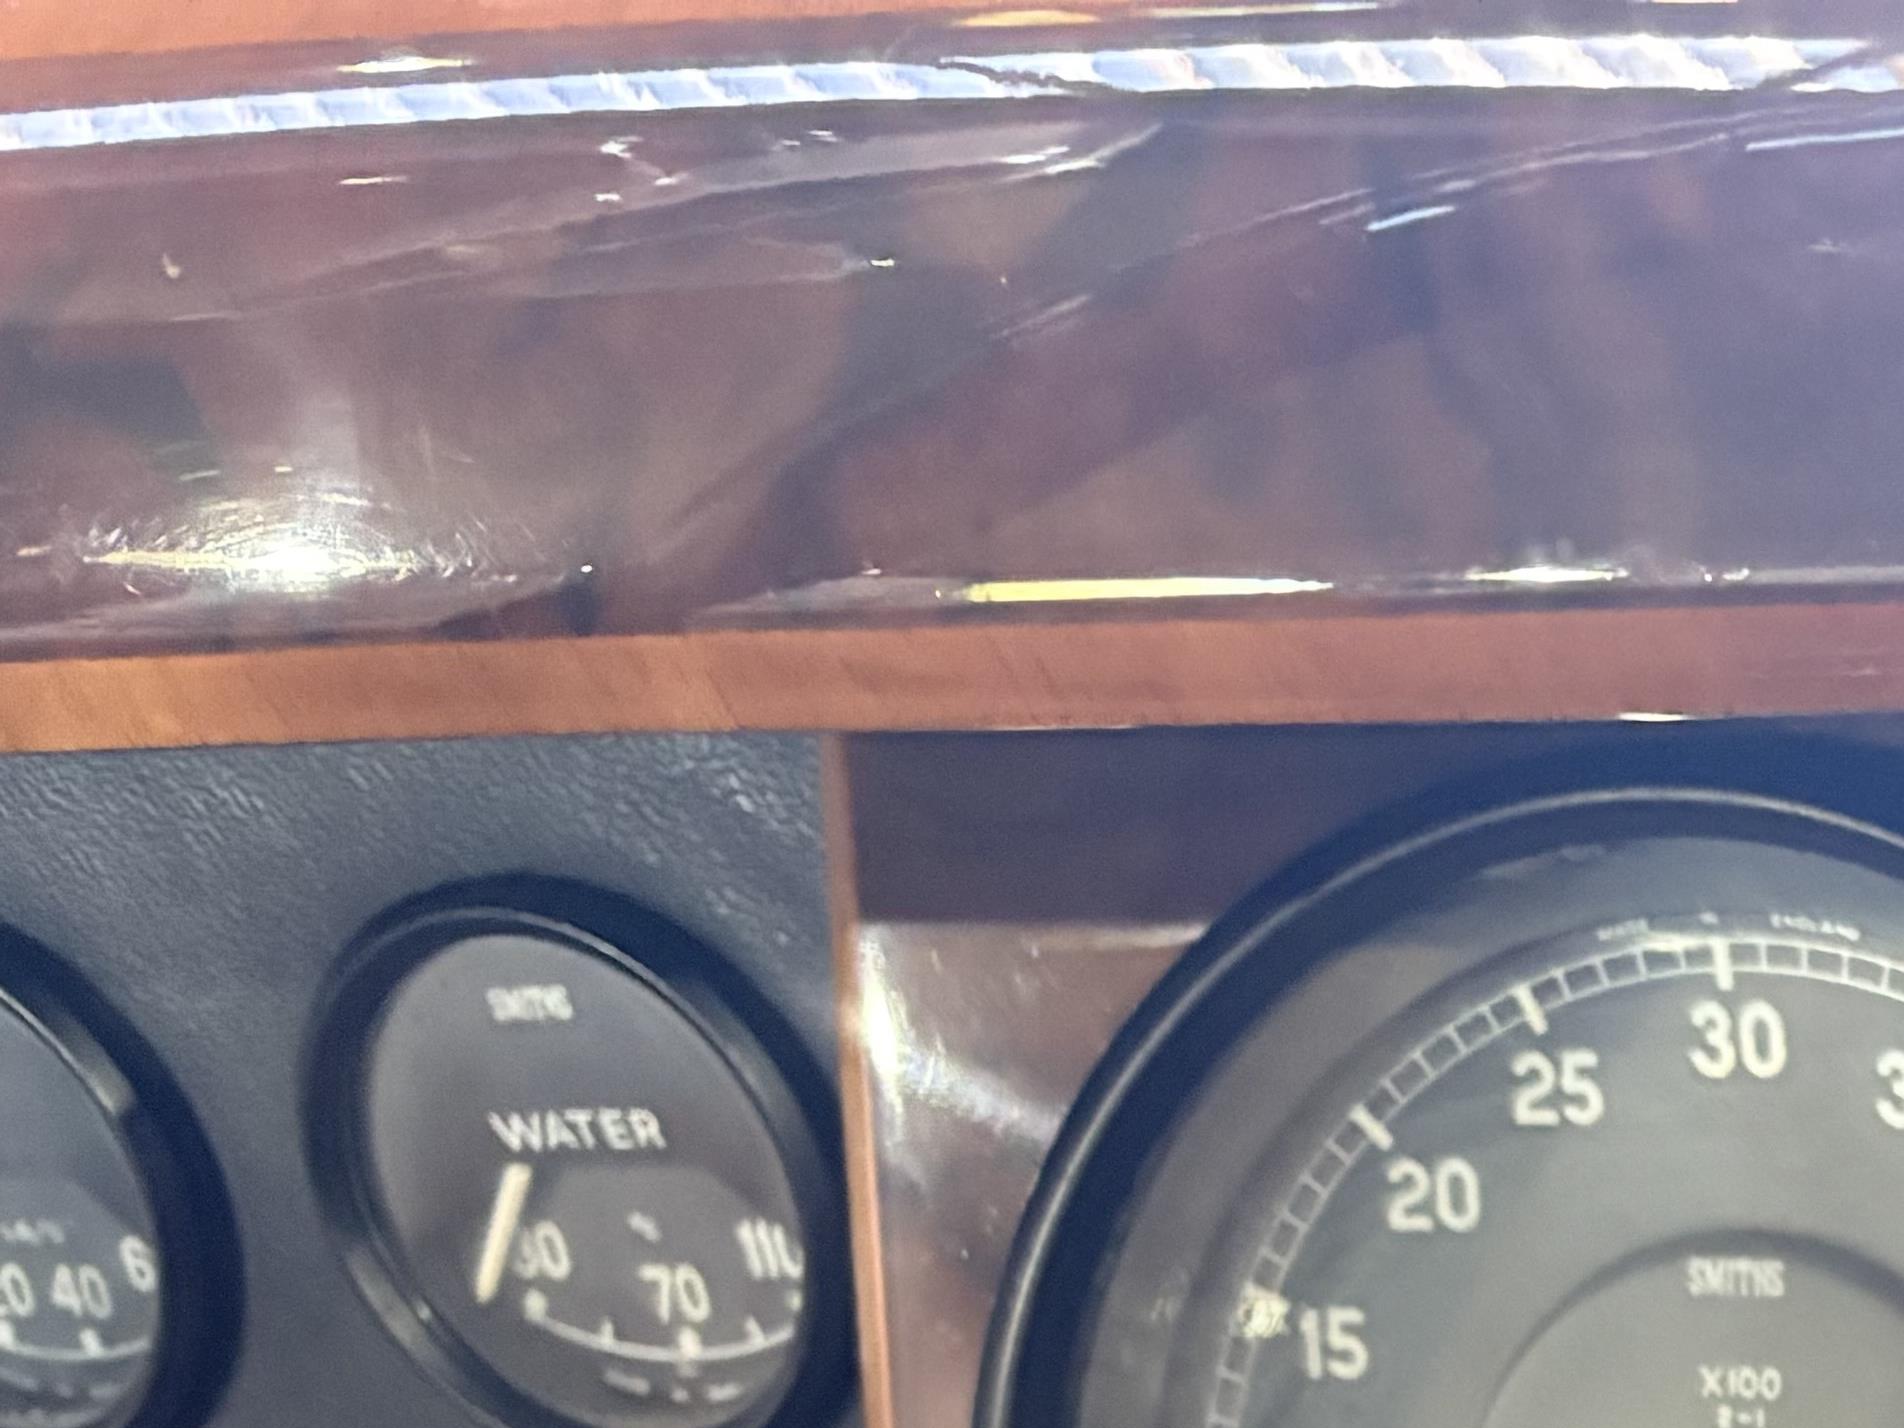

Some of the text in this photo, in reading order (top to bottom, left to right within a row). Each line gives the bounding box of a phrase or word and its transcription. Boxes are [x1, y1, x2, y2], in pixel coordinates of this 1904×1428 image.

[1689, 1000, 1788, 1079] 30
[1512, 1049, 1605, 1126] 25
[488, 1107, 668, 1152] WATER
[1385, 1156, 1482, 1232] 20
[52, 1263, 113, 1320] 40
[638, 1261, 711, 1325] 70
[1687, 1255, 1785, 1297] SMITHS
[1300, 1305, 1369, 1380] 15
[1697, 1364, 1783, 1401] X100
